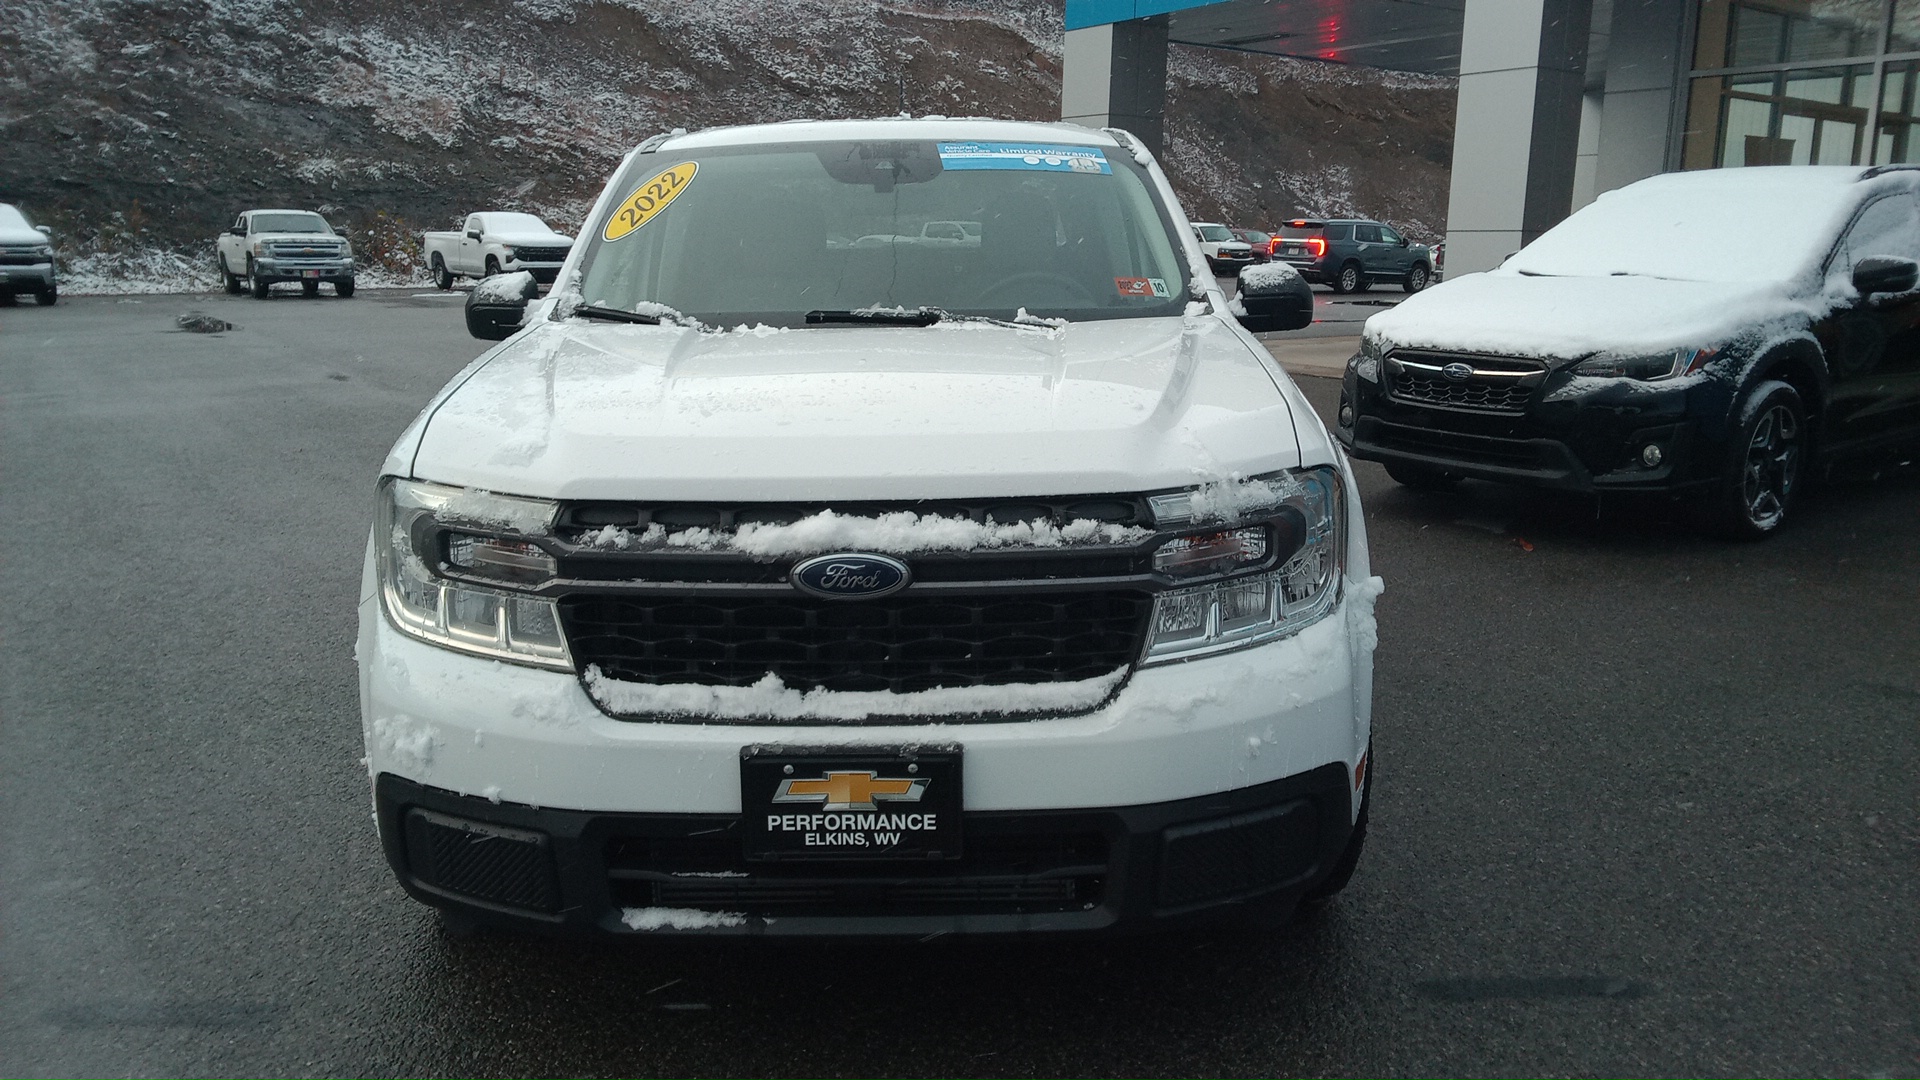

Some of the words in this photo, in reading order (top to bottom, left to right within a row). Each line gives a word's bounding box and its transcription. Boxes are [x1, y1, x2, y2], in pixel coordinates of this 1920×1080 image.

[1043, 149, 1096, 158] Warranty
[620, 172, 685, 228] 2022
[1153, 282, 1165, 293] 10
[820, 563, 881, 588] Ford
[767, 814, 937, 831] PERFORMANCE
[805, 832, 870, 847] ELKINS,
[874, 832, 901, 845] WV
